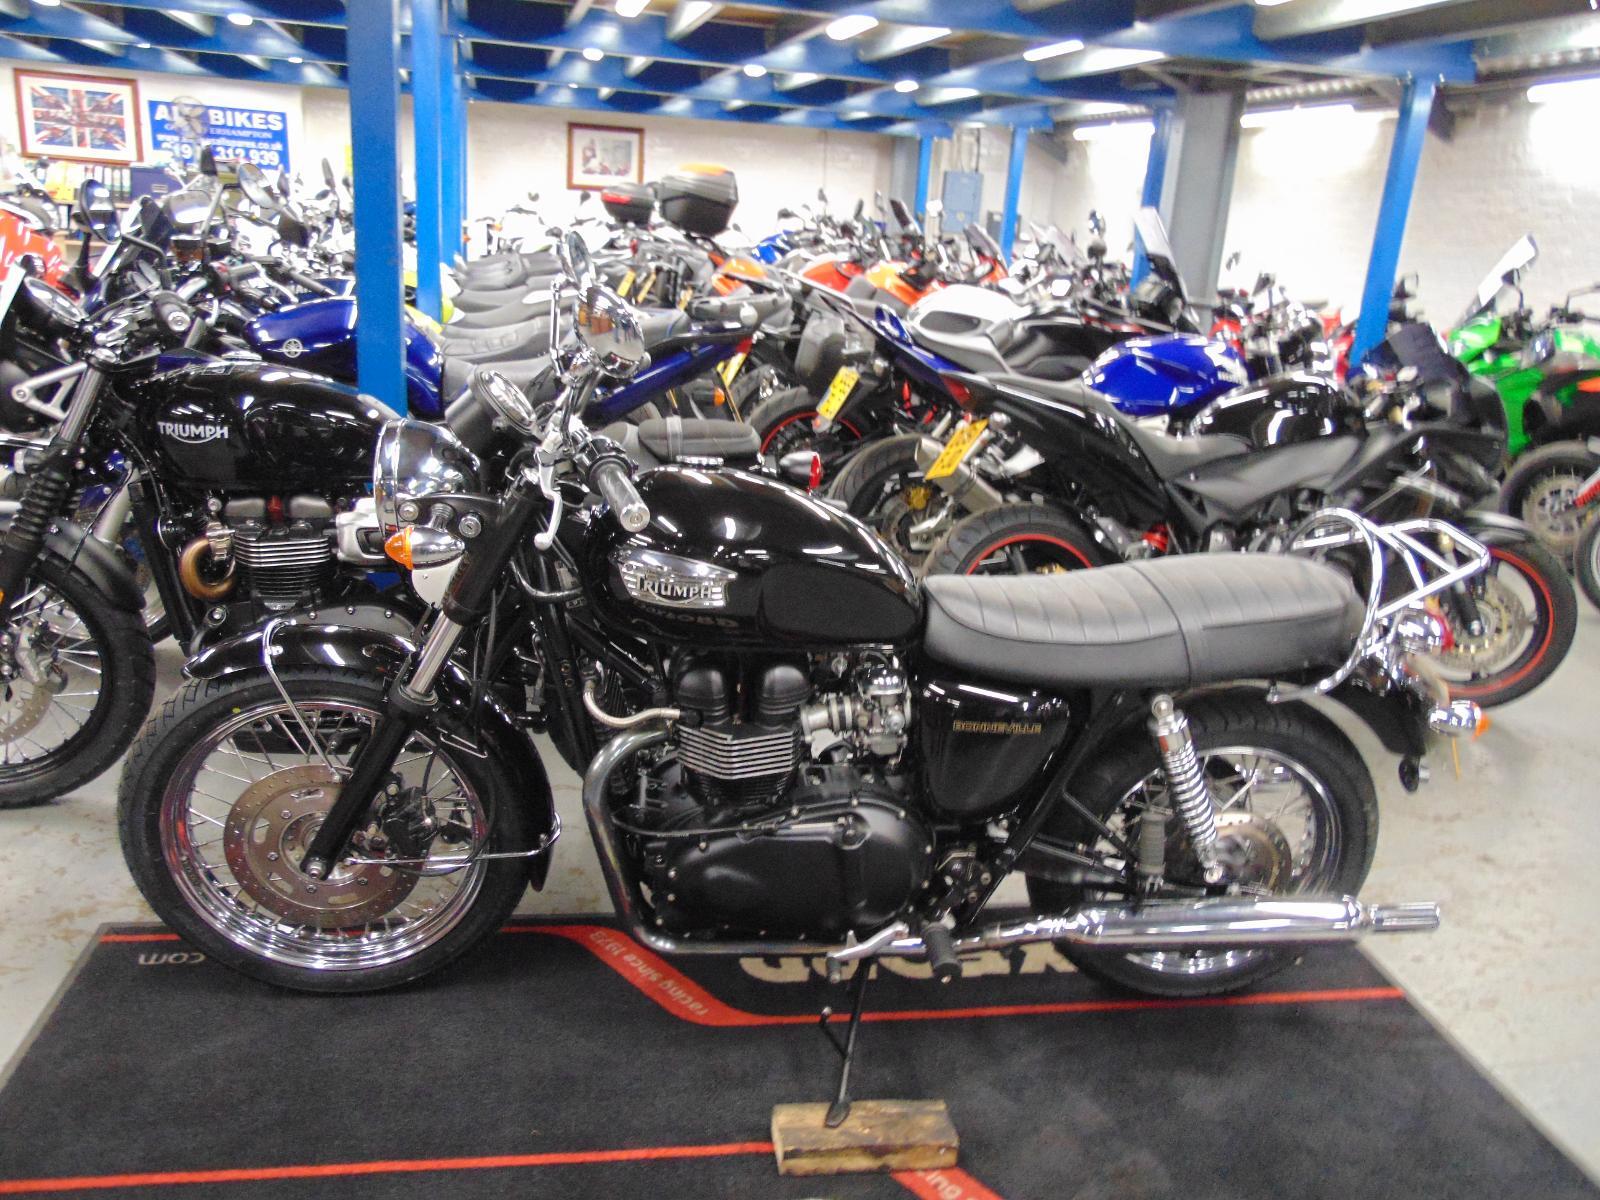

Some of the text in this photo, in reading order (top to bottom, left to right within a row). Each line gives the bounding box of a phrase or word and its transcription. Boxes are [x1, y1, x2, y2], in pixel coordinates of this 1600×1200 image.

[208, 109, 283, 131] BIKES
[157, 421, 229, 444] TRIUMPH
[634, 574, 713, 603] TRIUMPH
[623, 953, 663, 982] since
[660, 979, 709, 1016] racing
